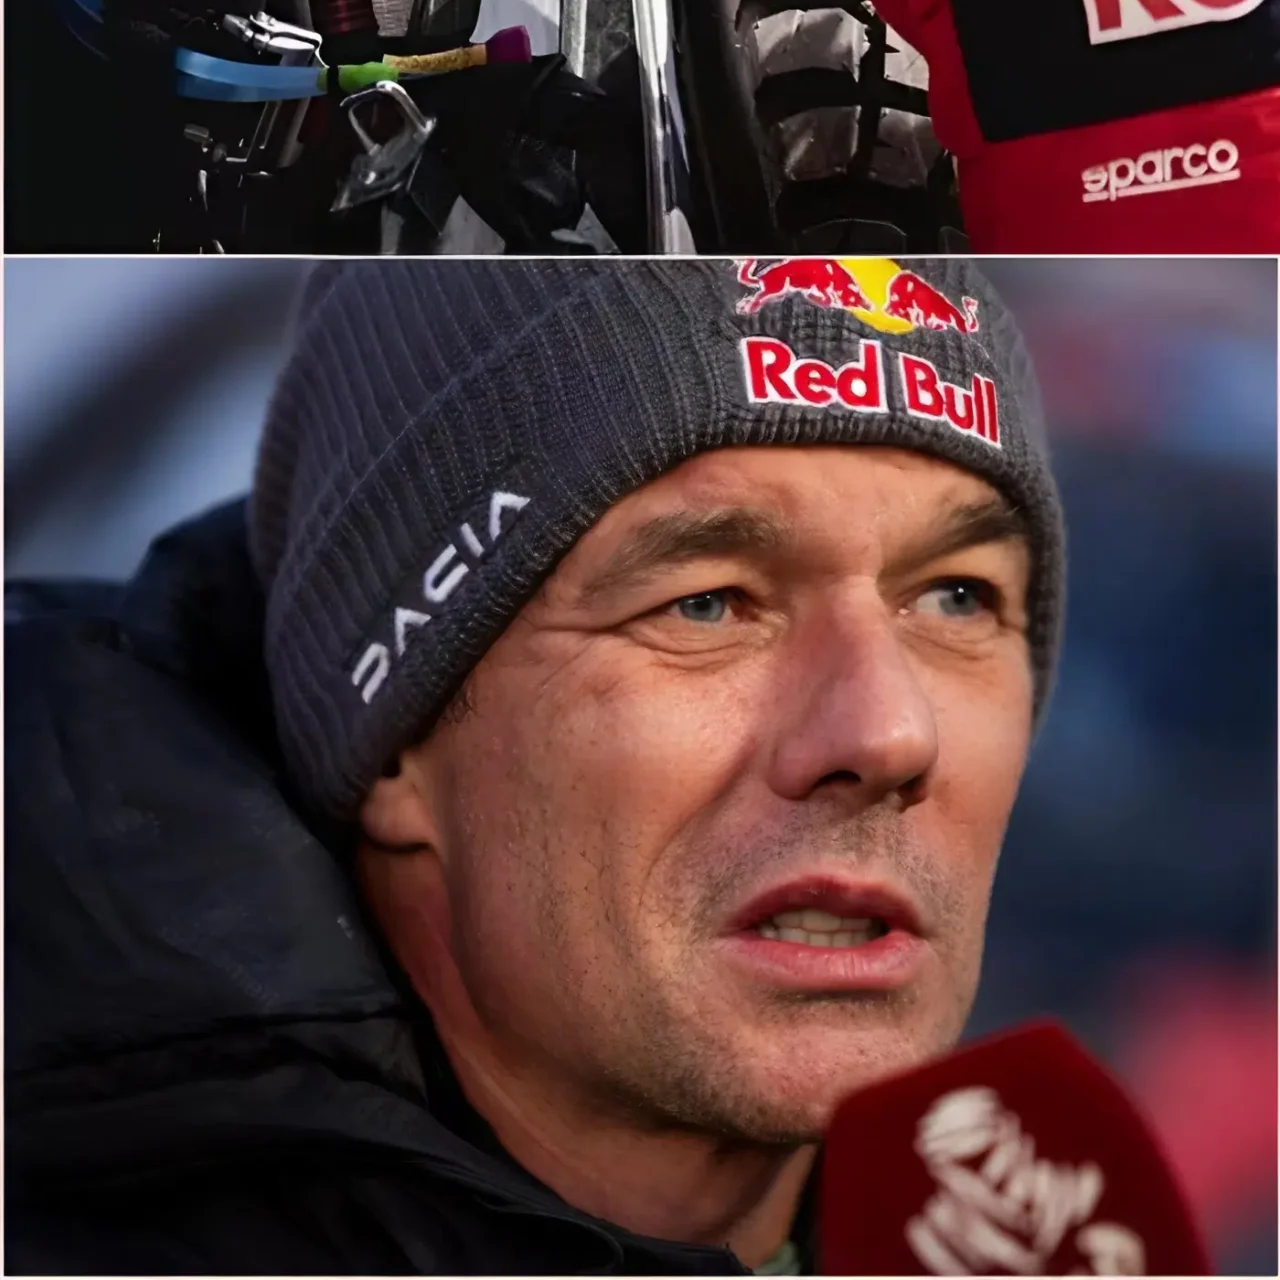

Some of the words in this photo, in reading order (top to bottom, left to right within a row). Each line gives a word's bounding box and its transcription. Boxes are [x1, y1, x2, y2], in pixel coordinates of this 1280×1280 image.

[1082, 138, 1240, 204] sparco
[739, 336, 889, 413] Red
[899, 351, 1002, 449] Bull
